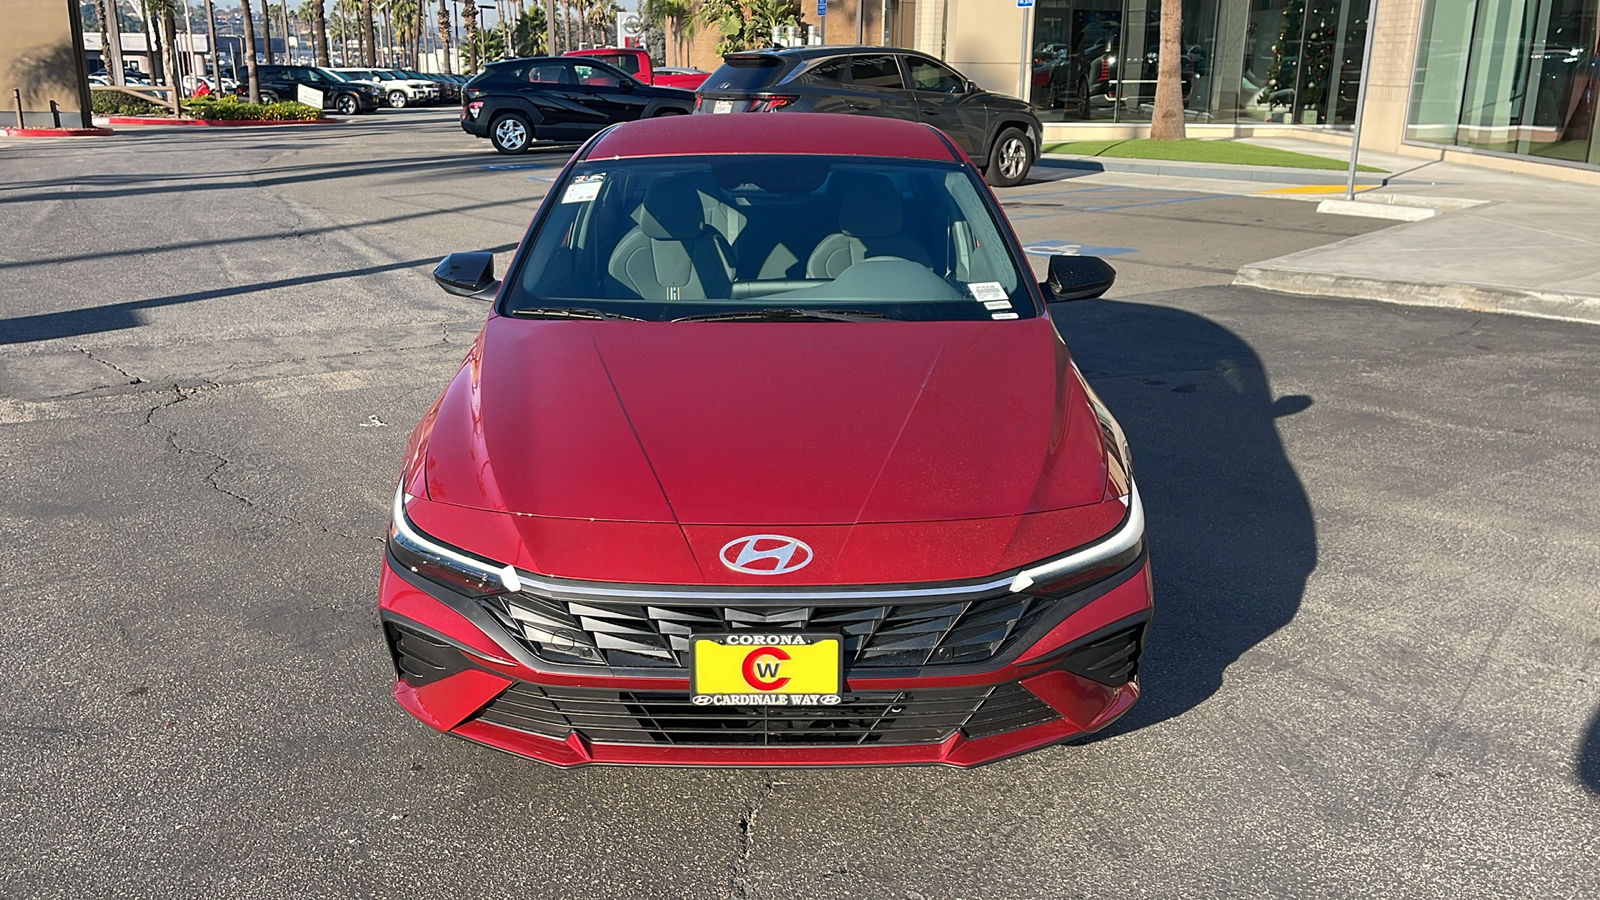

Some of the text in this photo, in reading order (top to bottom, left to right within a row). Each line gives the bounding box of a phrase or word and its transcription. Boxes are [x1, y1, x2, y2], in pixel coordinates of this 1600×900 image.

[726, 635, 806, 645] CORONA
[713, 695, 821, 706] CARDINALE WAY
